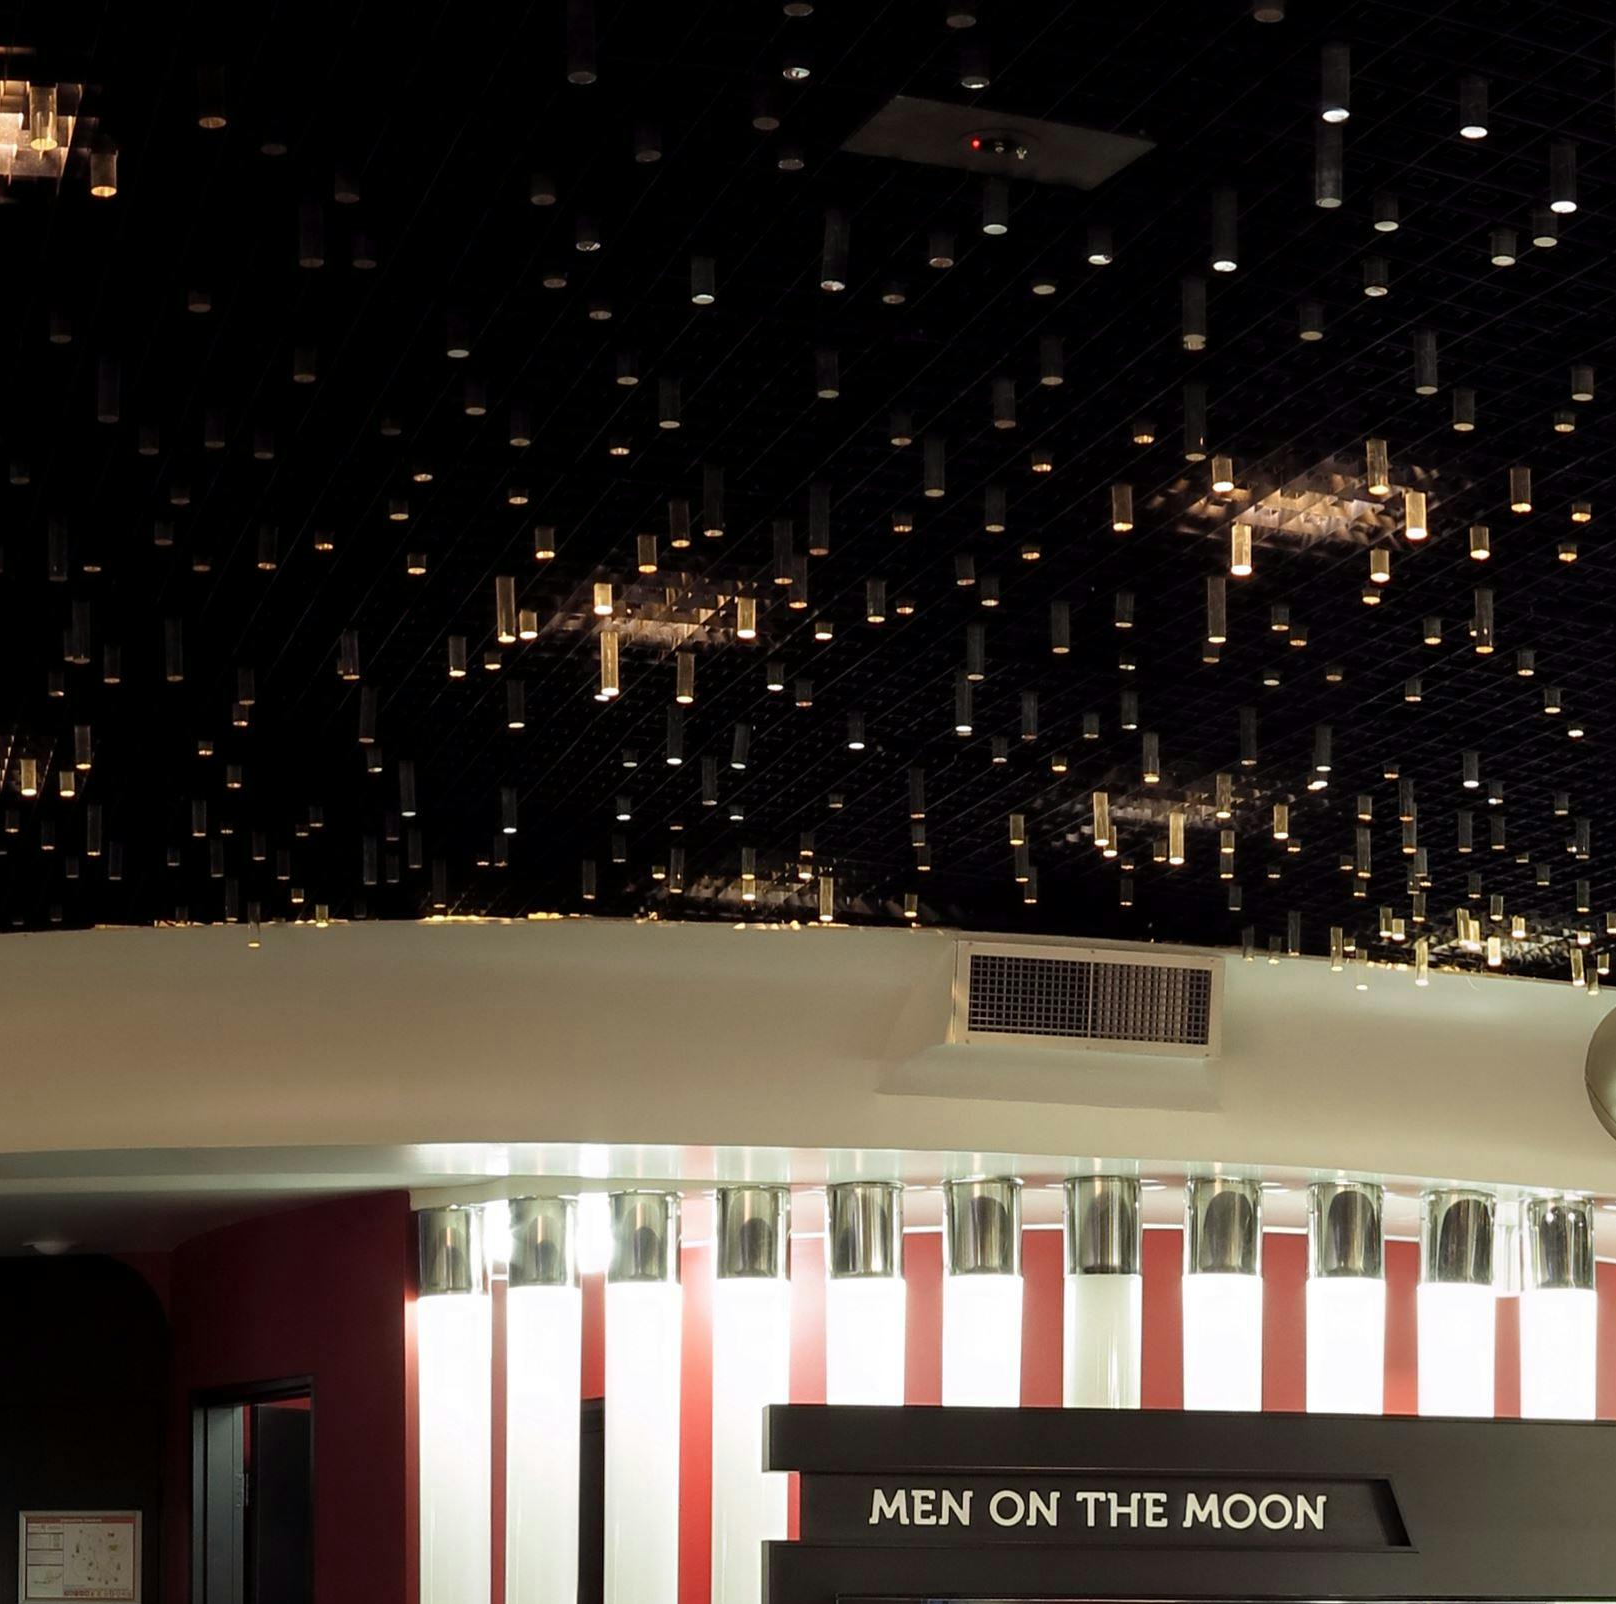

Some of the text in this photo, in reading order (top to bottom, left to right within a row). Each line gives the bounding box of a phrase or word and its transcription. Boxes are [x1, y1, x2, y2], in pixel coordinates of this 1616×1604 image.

[869, 1489, 1327, 1530] MEN ON THE MOON
